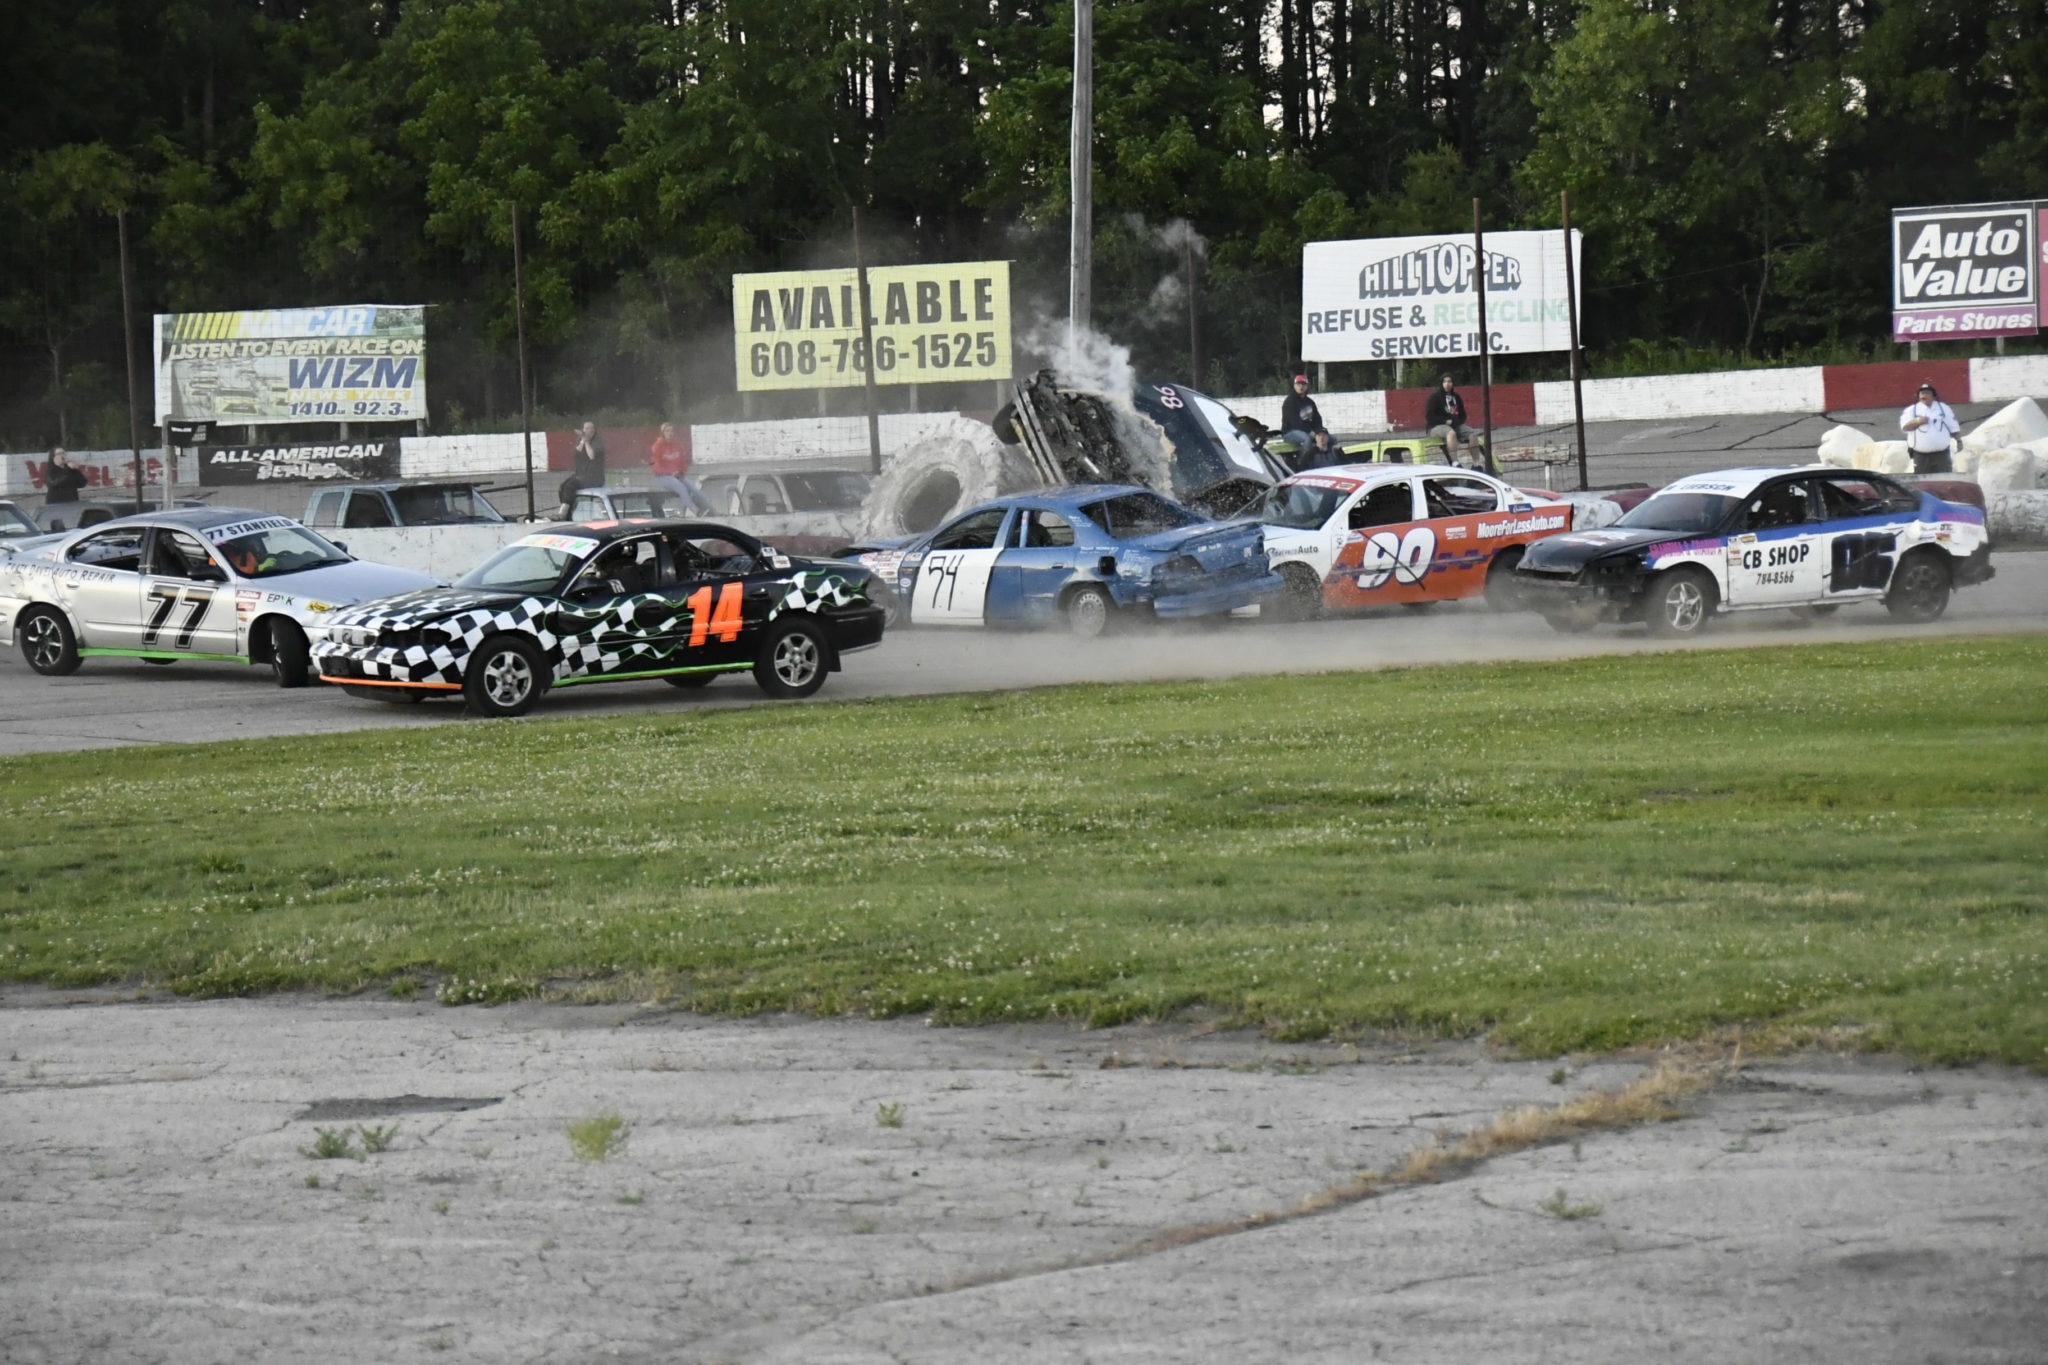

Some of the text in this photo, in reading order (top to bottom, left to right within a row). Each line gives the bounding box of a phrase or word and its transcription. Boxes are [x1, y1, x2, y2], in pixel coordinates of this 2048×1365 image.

[1907, 221, 2020, 259] Auto
[1902, 259, 2026, 297] Value
[1308, 306, 1402, 334] REFUSE
[1409, 304, 1426, 327] &
[1897, 312, 2032, 334] Parts Stores
[169, 341, 236, 361] LISTEN
[239, 341, 268, 357] TO
[270, 340, 333, 356] EVERY
[335, 338, 388, 354] RACE
[751, 332, 996, 377] 608-786-1525
[1371, 333, 1461, 358] SERVICE
[288, 357, 418, 389] WIZM
[353, 402, 402, 415] 92.3
[210, 443, 384, 465] ALL-AMERICAN
[206, 519, 294, 540] 77 STANFIELD
[1476, 515, 1565, 539] MooreForLessAuto.com
[1356, 526, 1437, 589] 90
[1743, 551, 1762, 570] CB
[1768, 543, 1810, 568] SHOP
[54, 567, 79, 579] AUTO
[80, 569, 117, 582] REPAIR
[1756, 572, 1795, 586] 784-8566
[142, 581, 220, 649] 77
[687, 581, 744, 647] 14
